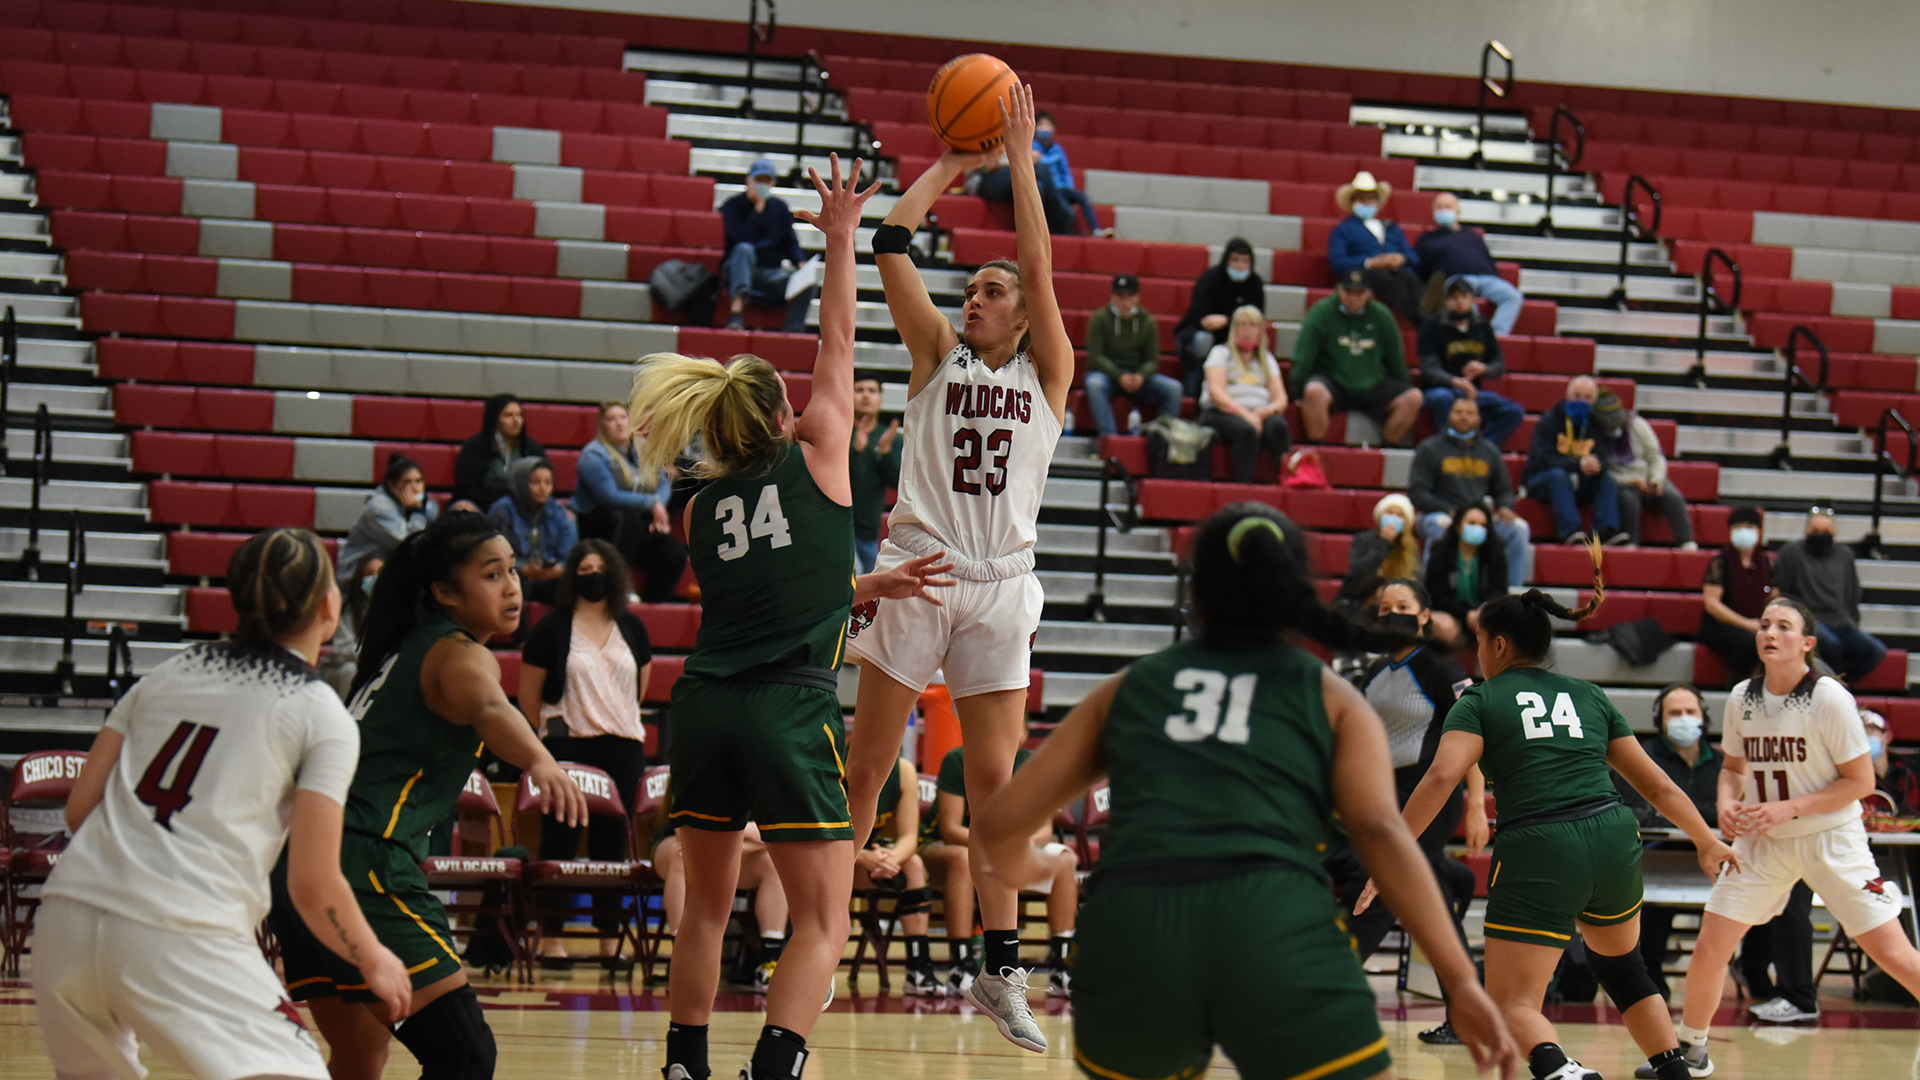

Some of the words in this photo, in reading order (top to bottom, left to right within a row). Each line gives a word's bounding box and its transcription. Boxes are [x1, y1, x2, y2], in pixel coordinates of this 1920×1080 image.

[952, 427, 1013, 496] 23
[715, 484, 792, 561] 34
[1164, 667, 1258, 745] 31
[1515, 691, 1584, 740] 24
[22, 755, 64, 784] CHICO
[134, 720, 219, 833] 4
[1753, 770, 1790, 803] 11
[434, 860, 506, 873] WILDCATS
[559, 862, 631, 876] WILDCATS
